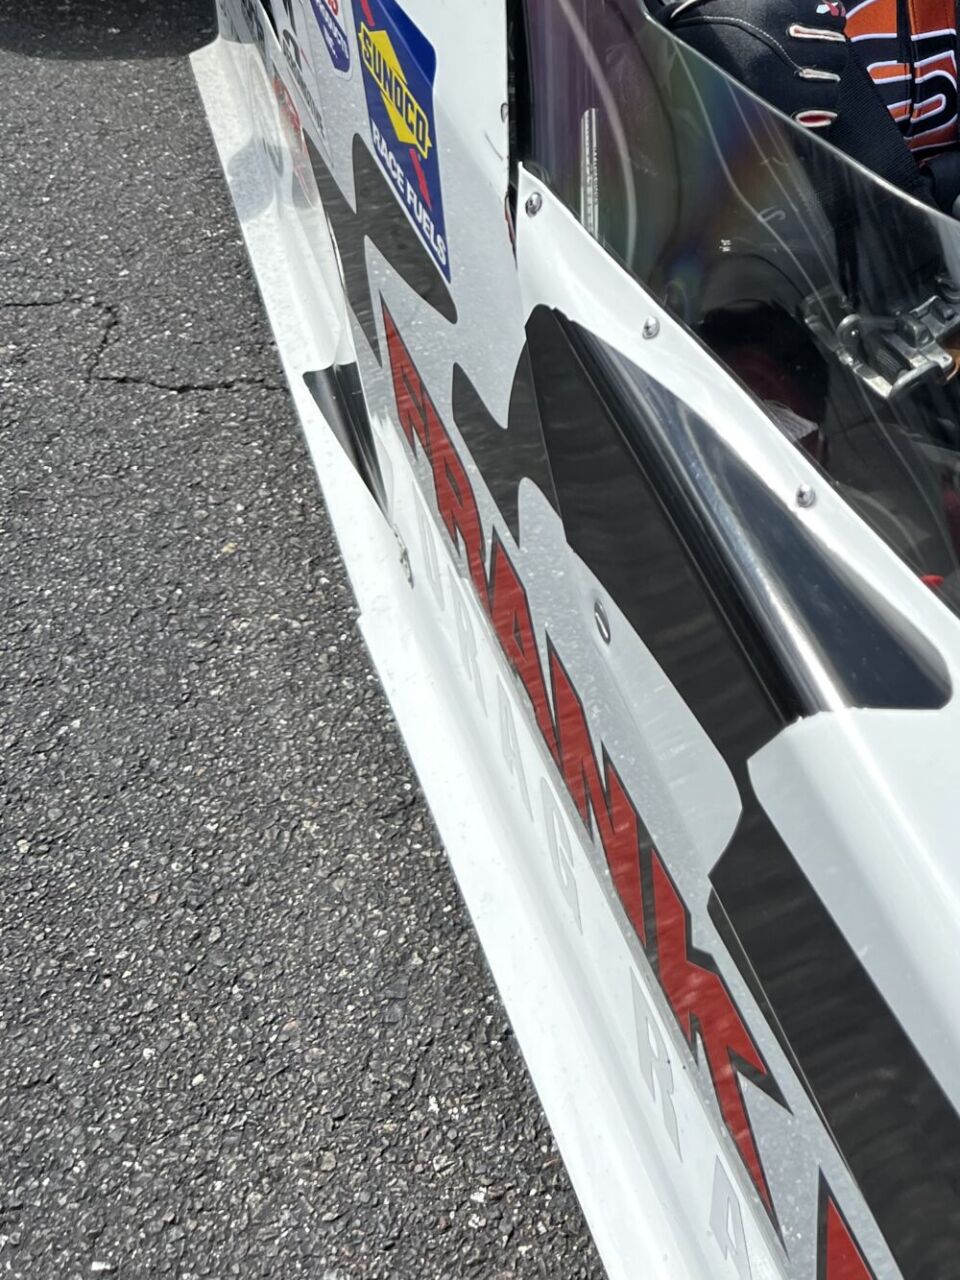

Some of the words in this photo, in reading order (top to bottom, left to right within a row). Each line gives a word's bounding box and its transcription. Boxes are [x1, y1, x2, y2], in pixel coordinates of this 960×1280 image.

[362, 28, 429, 152] SUNOCO
[371, 118, 406, 195] RACE
[405, 180, 448, 266] FUELS
